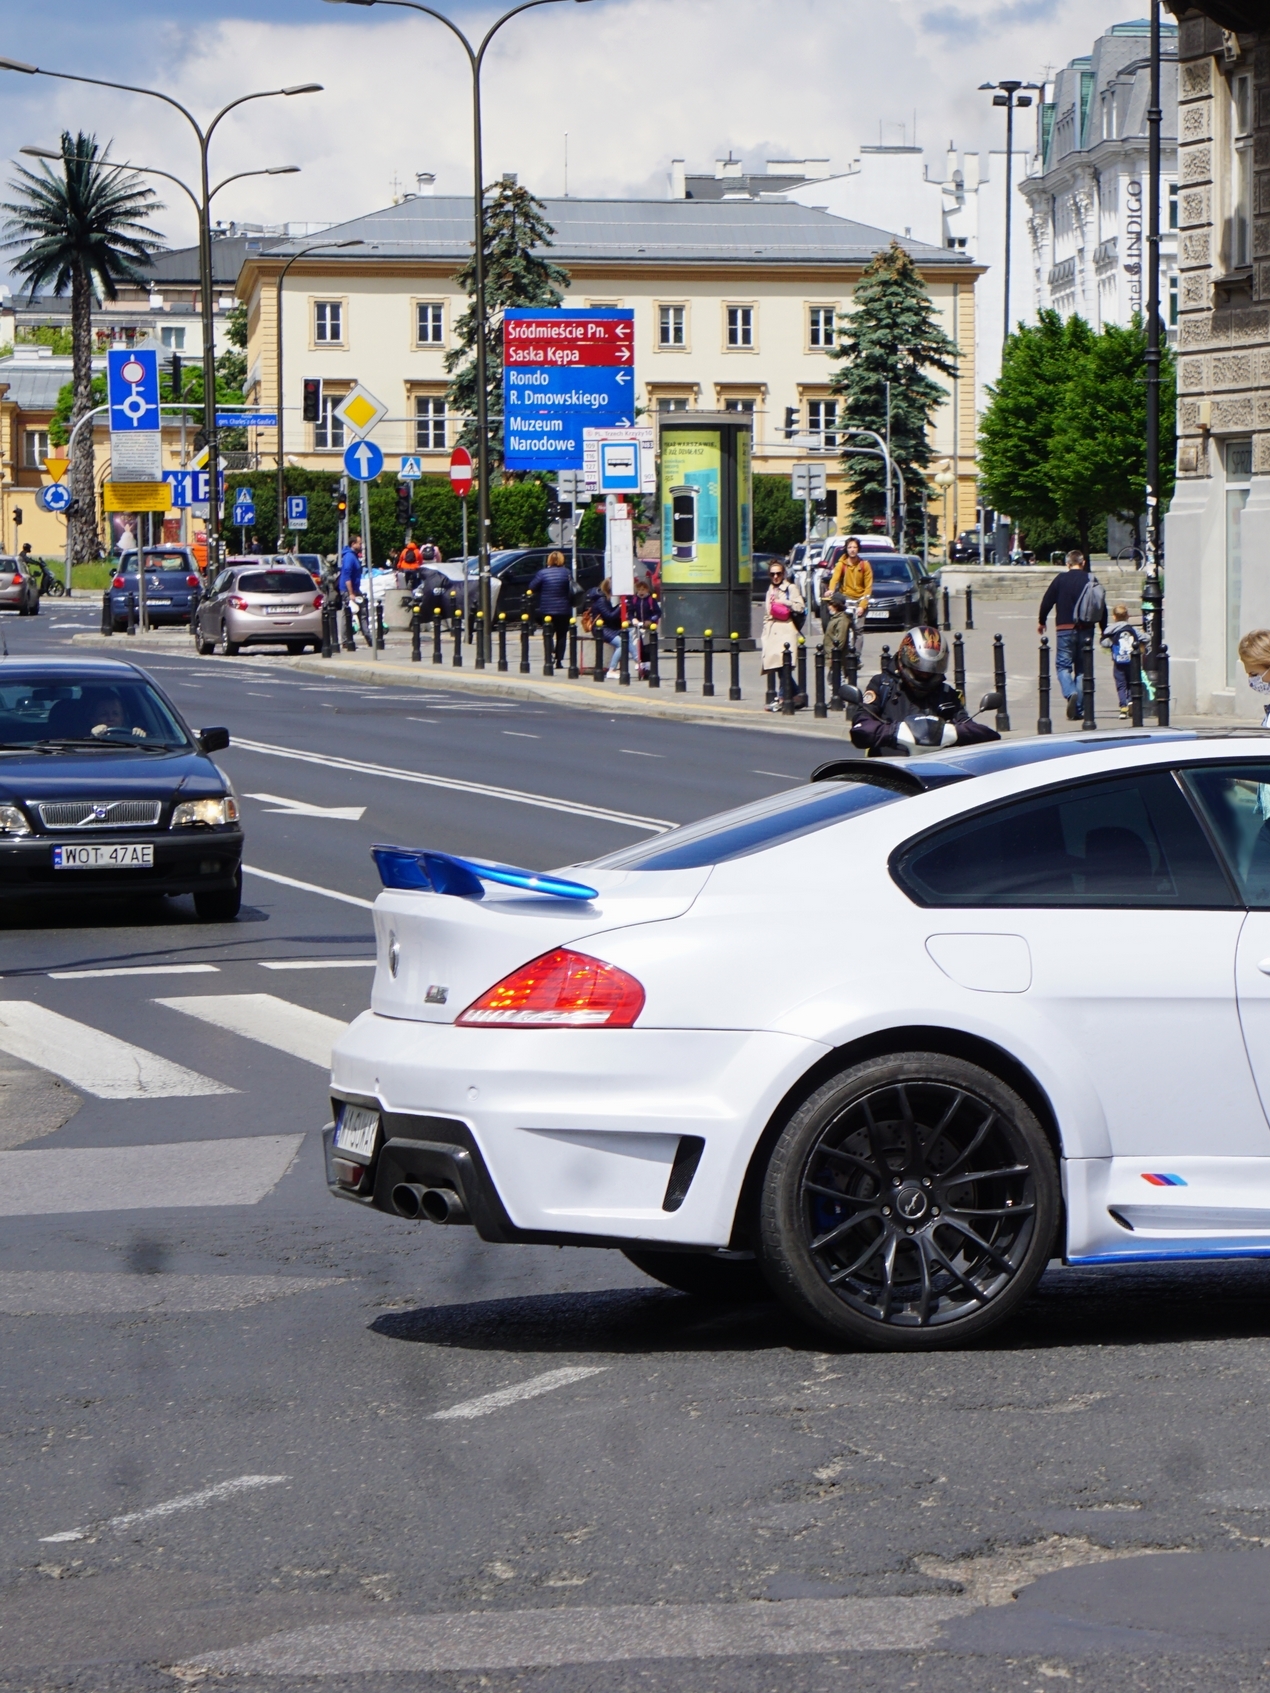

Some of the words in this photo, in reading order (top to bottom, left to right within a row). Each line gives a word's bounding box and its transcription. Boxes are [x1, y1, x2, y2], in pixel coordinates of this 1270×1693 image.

[1126, 181, 1142, 258] INDIGO
[1127, 281, 1142, 323] otel
[508, 321, 584, 338] Śródmieście
[587, 323, 609, 338] Pn.
[509, 347, 544, 361] Saska
[547, 347, 580, 364] Kępa
[509, 370, 549, 385] Rondo
[510, 390, 521, 404] R.
[524, 390, 609, 408] Dmowskiego
[510, 416, 563, 431] Muzeum
[510, 436, 576, 451] Narodowe
[292, 499, 303, 517] P
[65, 847, 101, 864] WOT
[109, 846, 152, 863] 47AE
